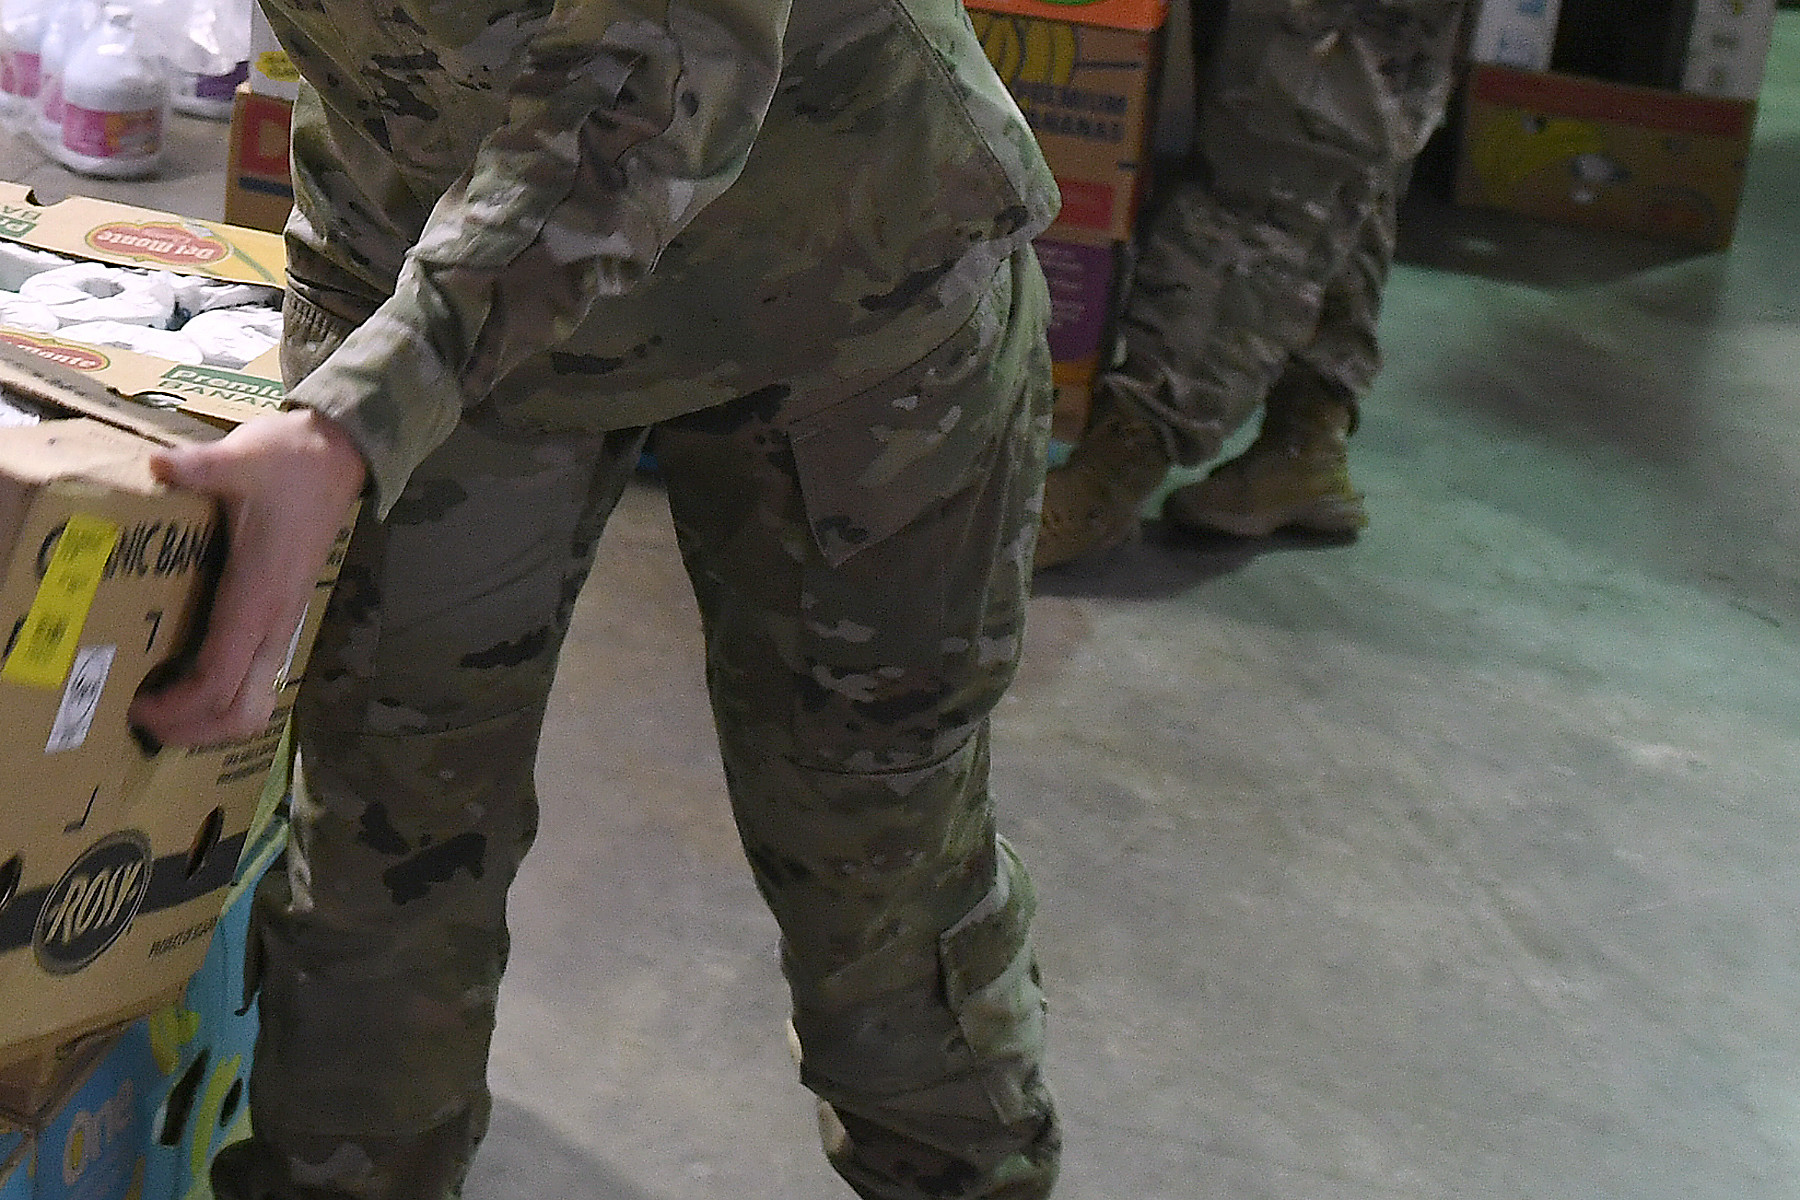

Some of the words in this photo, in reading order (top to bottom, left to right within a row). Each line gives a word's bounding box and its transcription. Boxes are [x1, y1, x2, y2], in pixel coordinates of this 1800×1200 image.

[157, 379, 283, 409] BANAN
[170, 368, 285, 400] Premiu
[41, 860, 146, 946] ROSY
